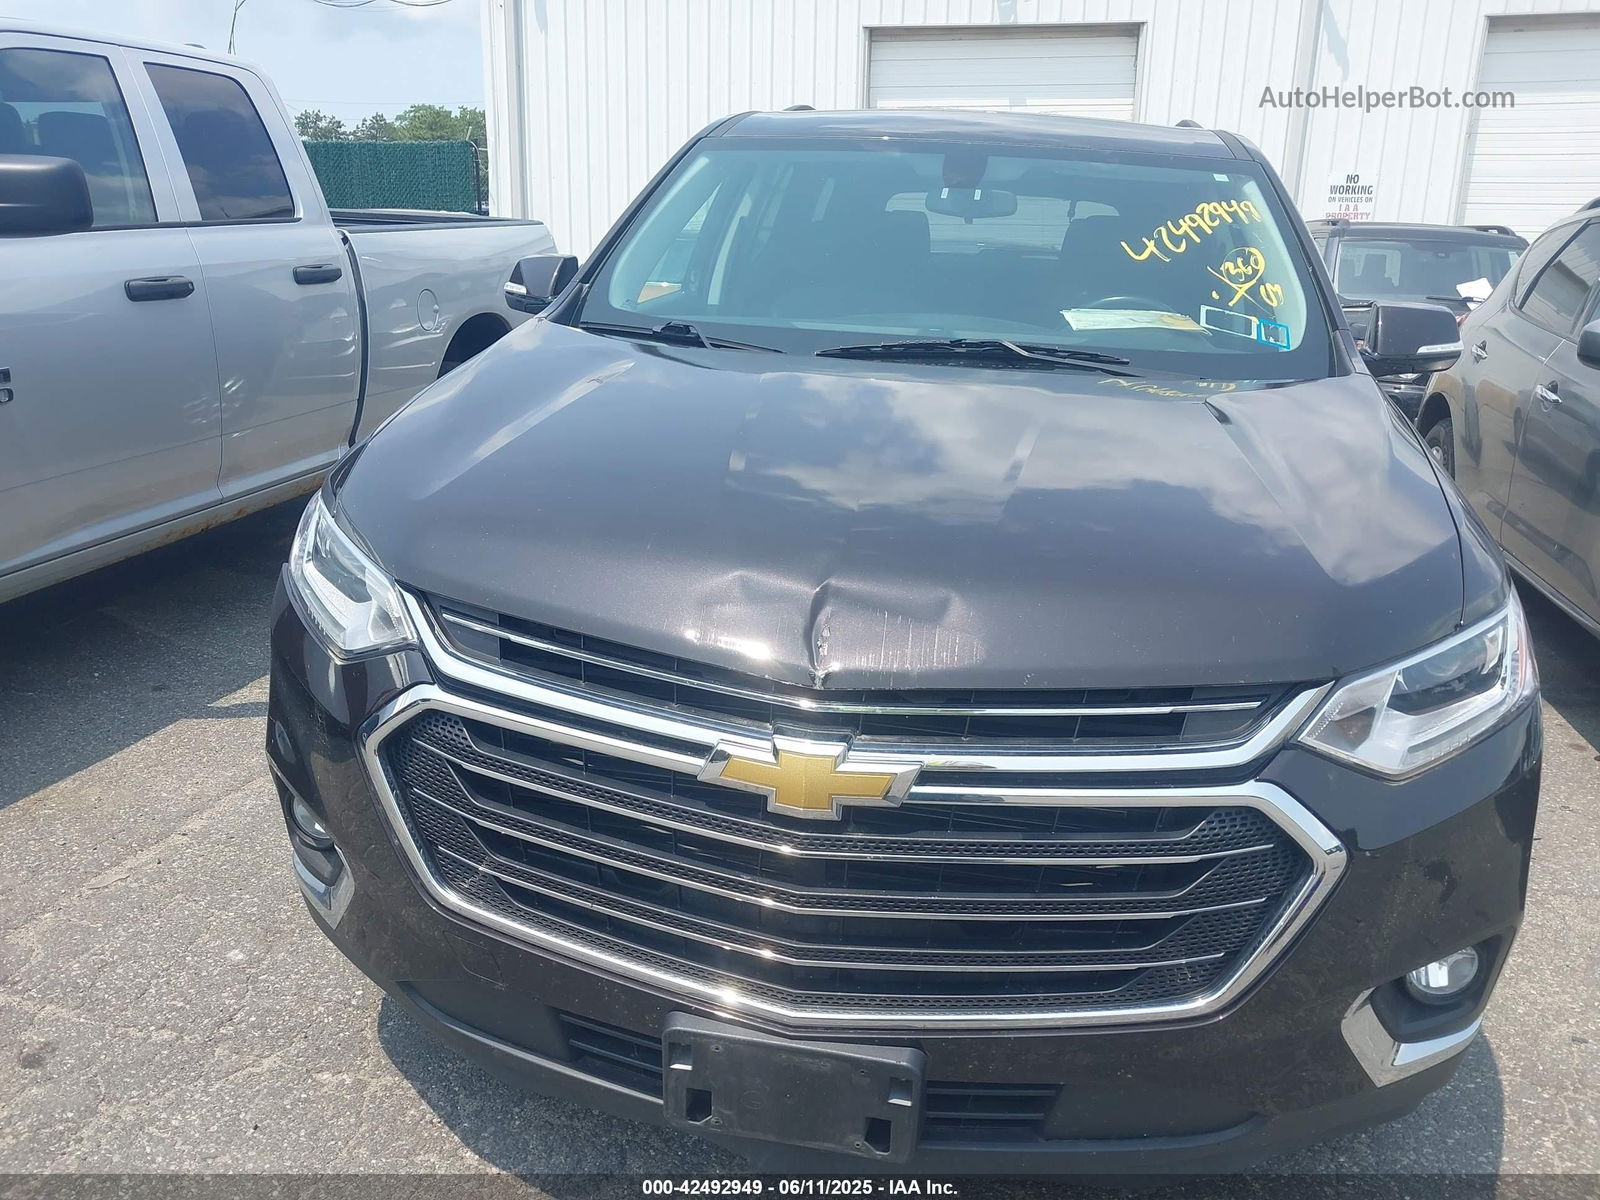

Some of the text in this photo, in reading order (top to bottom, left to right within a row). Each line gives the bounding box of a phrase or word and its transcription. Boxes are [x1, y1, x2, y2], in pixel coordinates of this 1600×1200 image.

[1345, 174, 1360, 185] NO
[1329, 185, 1373, 195] WORKING
[1325, 212, 1370, 220] PROPERTY
[1120, 199, 1262, 263] 42492949
